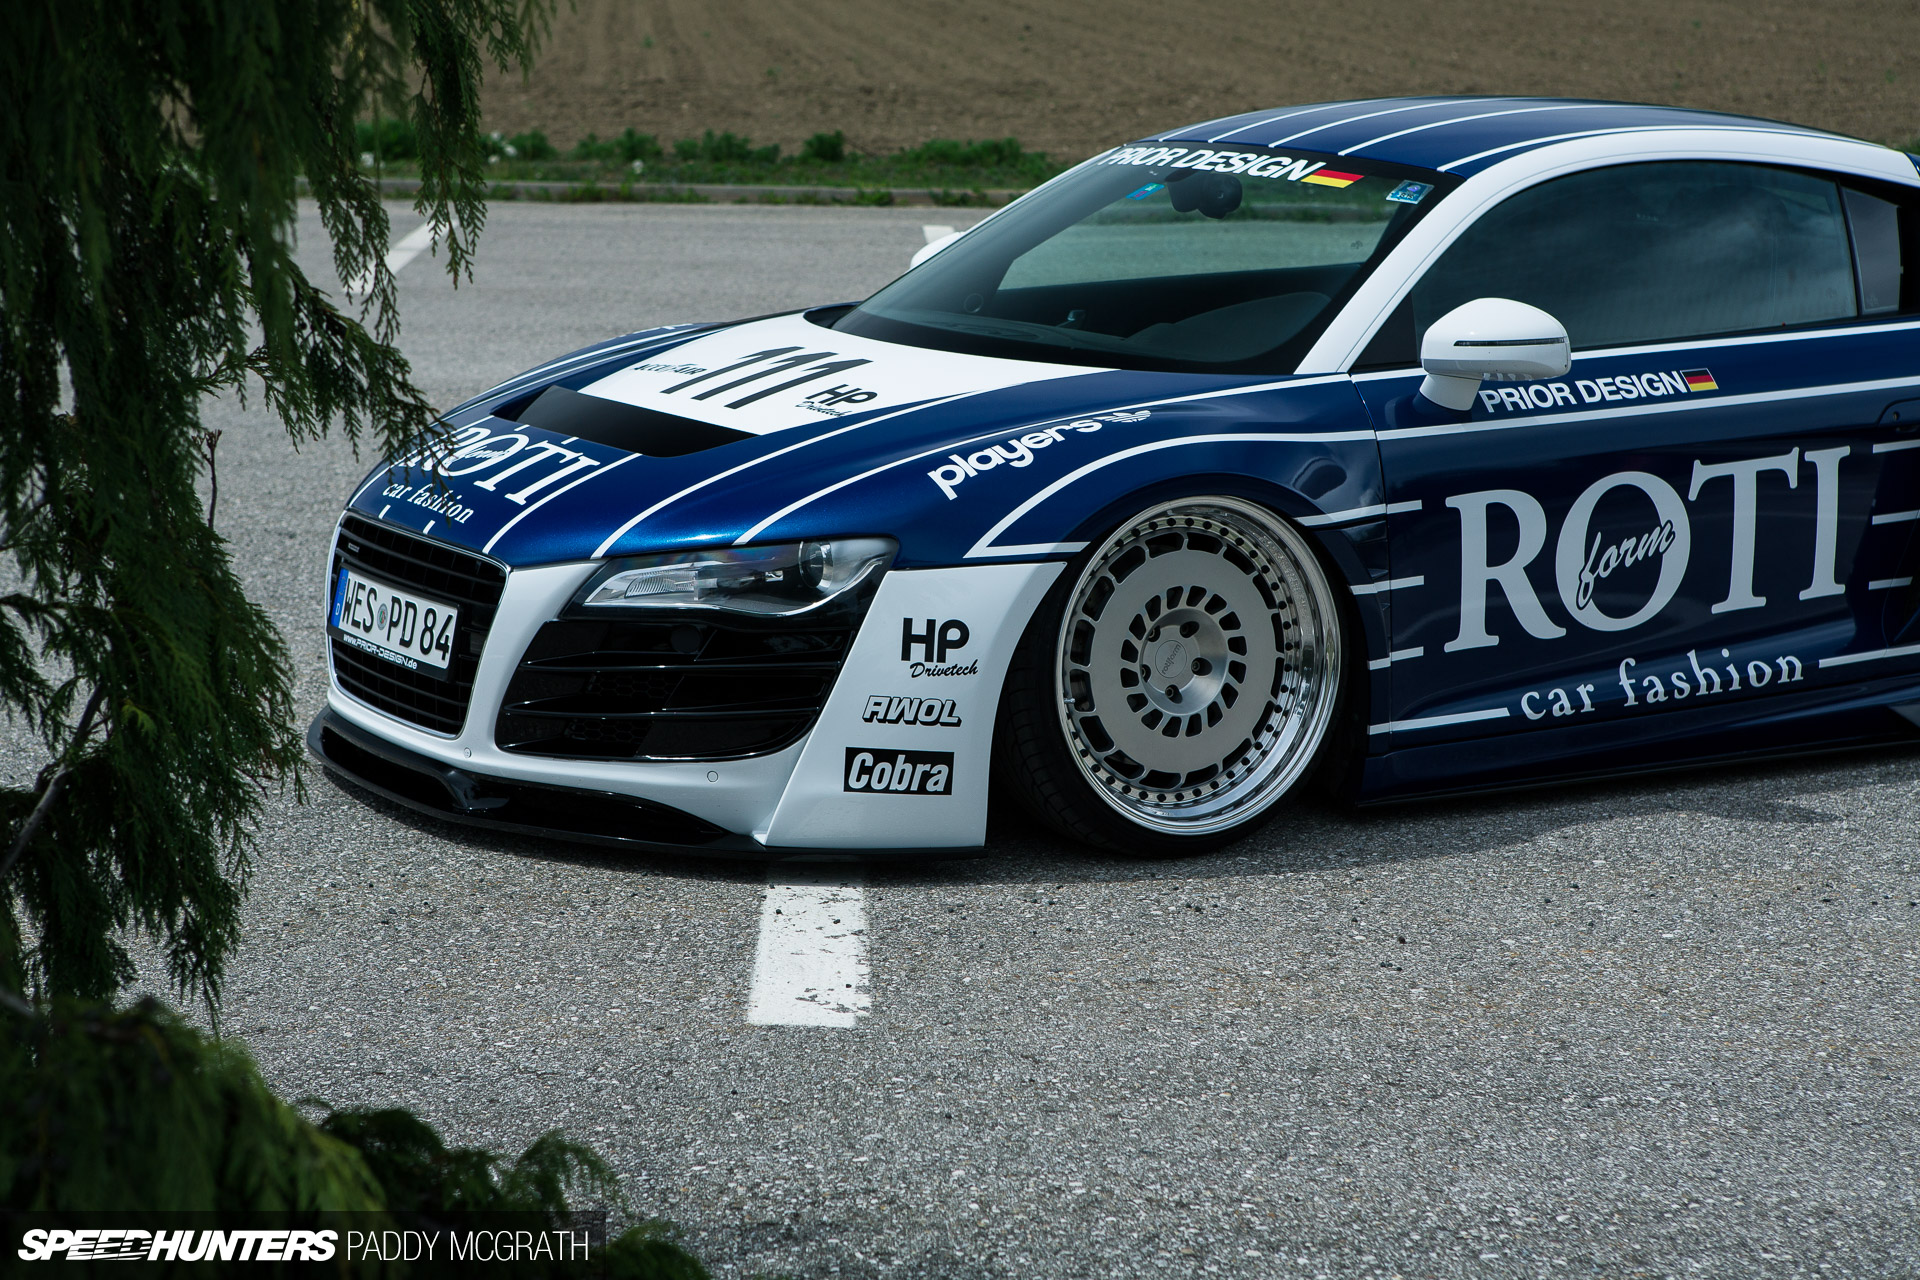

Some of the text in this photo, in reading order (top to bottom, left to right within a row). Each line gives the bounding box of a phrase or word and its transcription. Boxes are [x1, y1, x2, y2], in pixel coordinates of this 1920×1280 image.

[1097, 146, 1327, 182] PRIOR DESIGN
[660, 346, 874, 410] 111
[804, 383, 878, 406] HP
[1478, 370, 1688, 413] PRIOR DESIGN
[398, 427, 600, 506] ROTI
[927, 419, 1103, 501] players
[383, 483, 474, 524] car fashion
[1444, 445, 1851, 653] ROTI
[1576, 520, 1678, 611] form
[335, 603, 341, 616] D
[342, 577, 454, 661] WES PD 84
[343, 633, 418, 669] www.PRIOR-DESIGN.de
[901, 617, 970, 663] HP
[909, 659, 978, 678] Drivetech
[1520, 648, 1804, 721] car fashion
[862, 695, 962, 727] AWOL
[848, 751, 950, 792] Cobra
